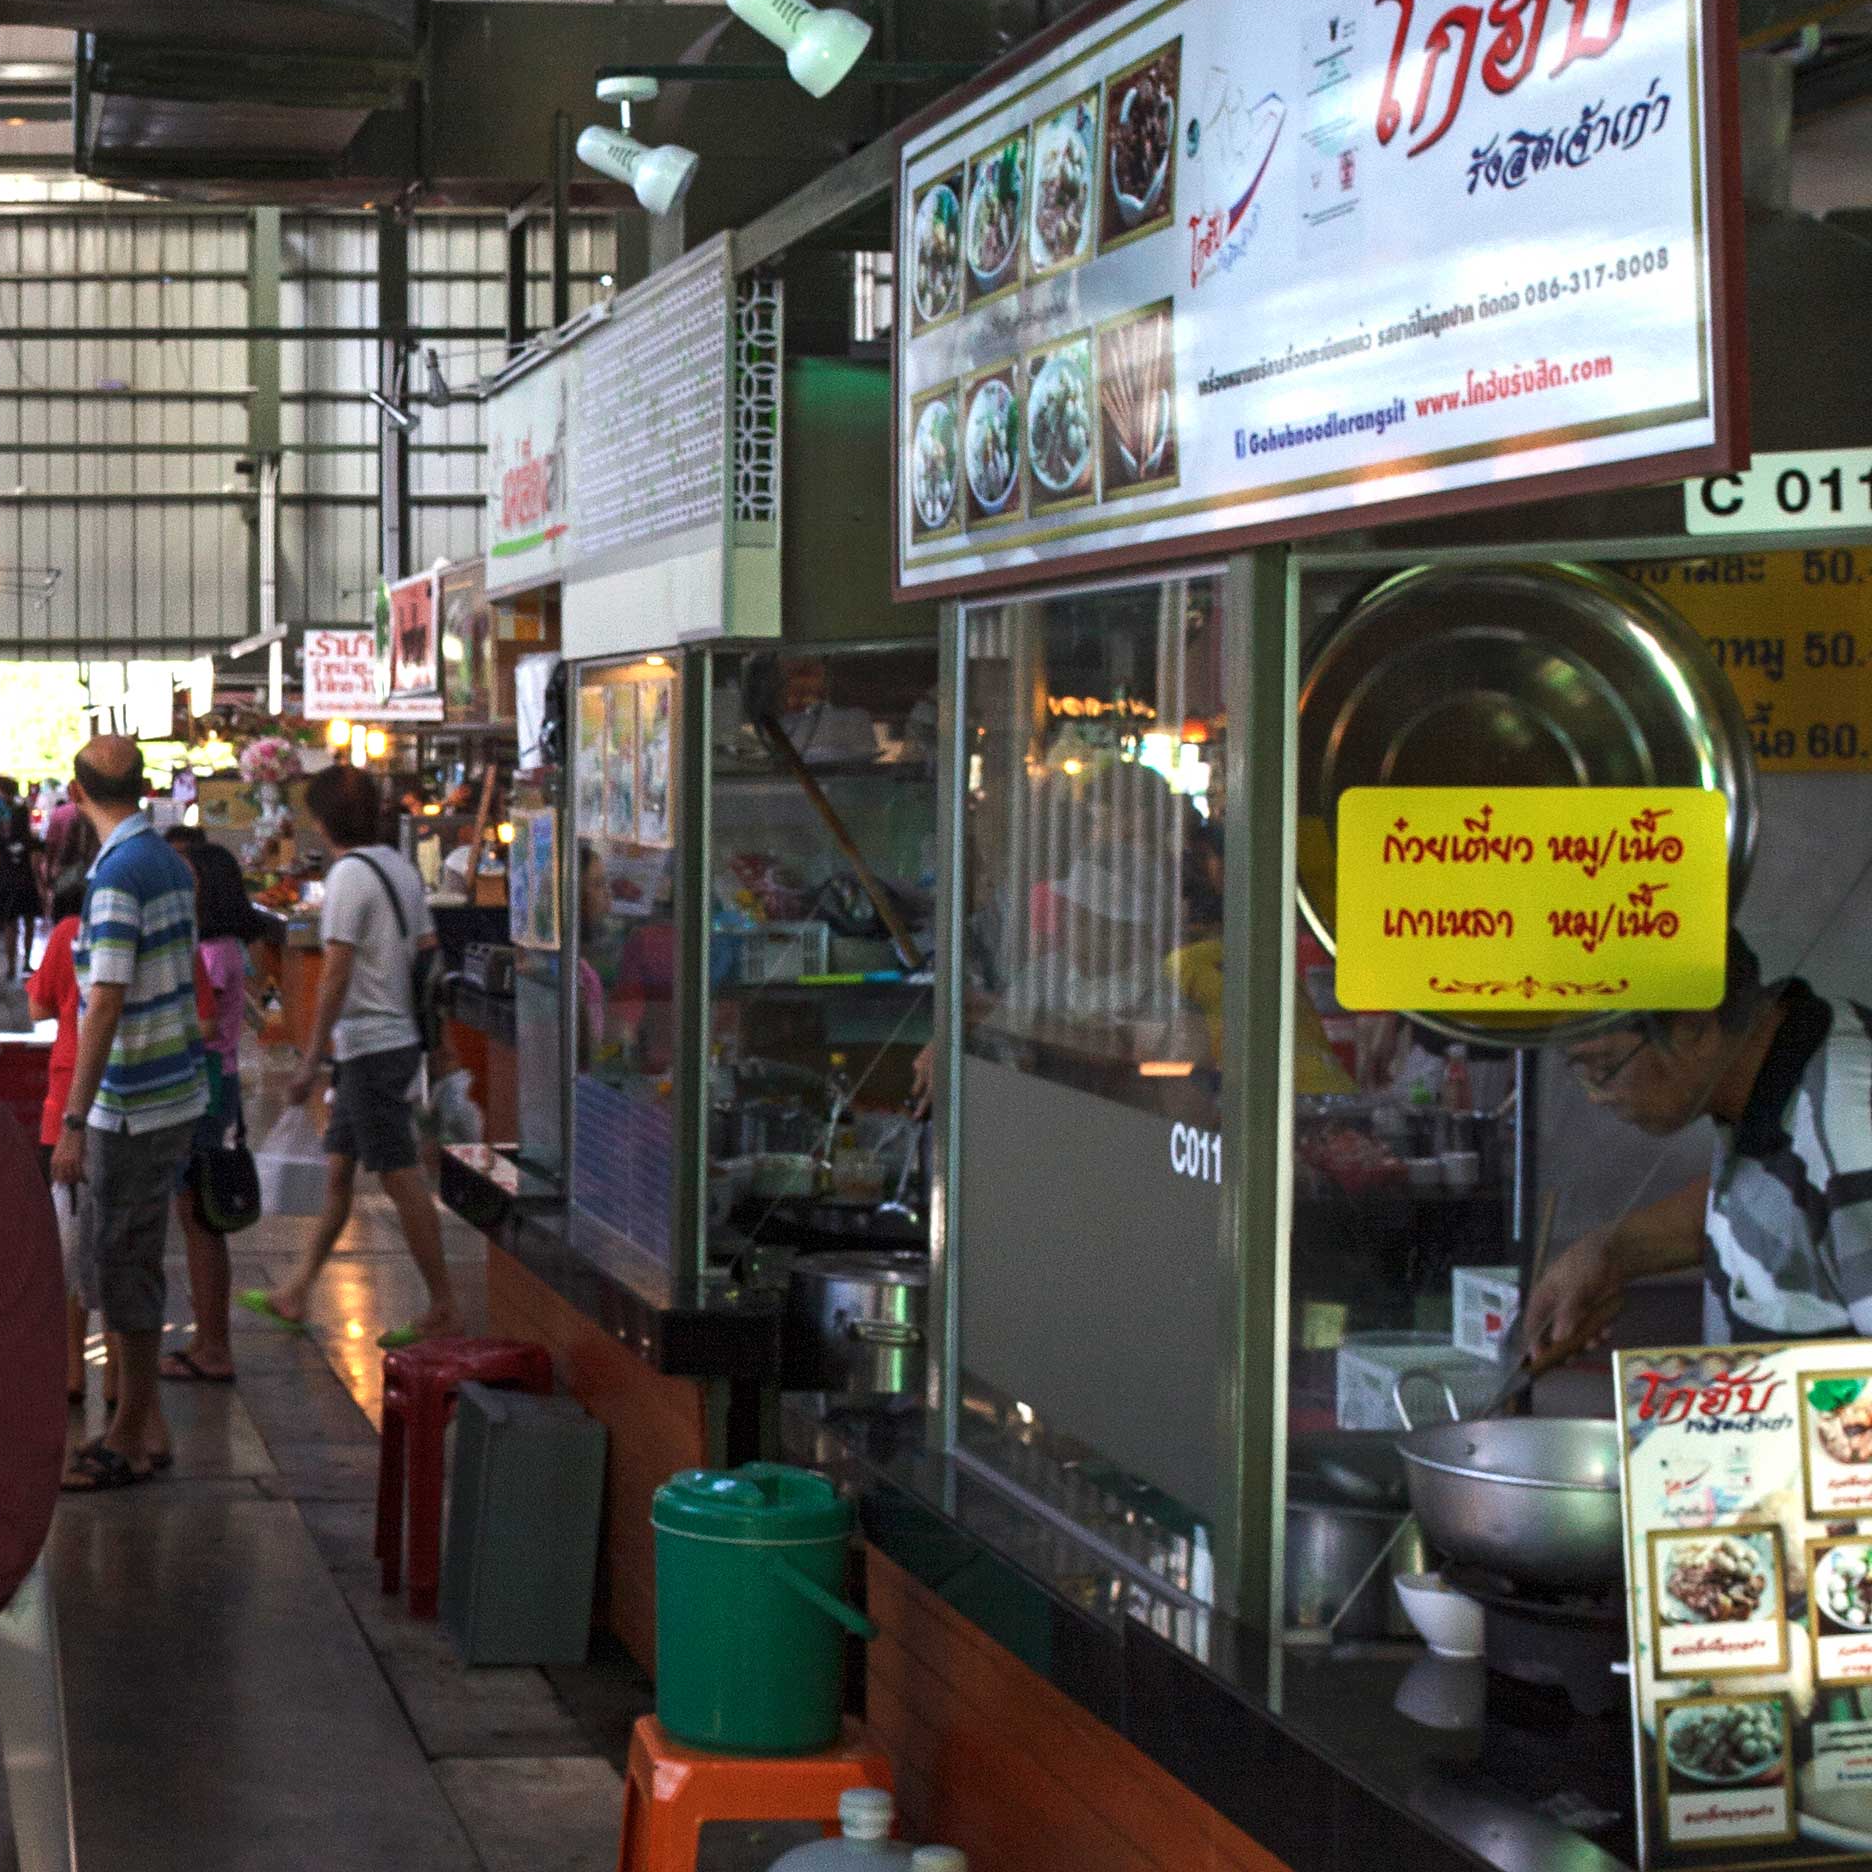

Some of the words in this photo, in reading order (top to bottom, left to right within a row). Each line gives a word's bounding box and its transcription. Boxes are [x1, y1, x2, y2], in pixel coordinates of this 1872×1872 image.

[1524, 246, 1670, 306] 086-317-8008
[1248, 398, 1406, 455] Gohubnoodlerangsit
[1700, 472, 1744, 516] C
[1777, 466, 1872, 514] 011
[1746, 702, 1796, 758] นื้อ
[1382, 804, 1534, 865] ก๋วยเตี๋ยว
[1546, 808, 1685, 879] หมู/เนื้อ
[1382, 908, 1515, 939] เกาเหลา
[1546, 882, 1681, 954] หมู/เนื้อ
[1170, 1121, 1222, 1185] C011
